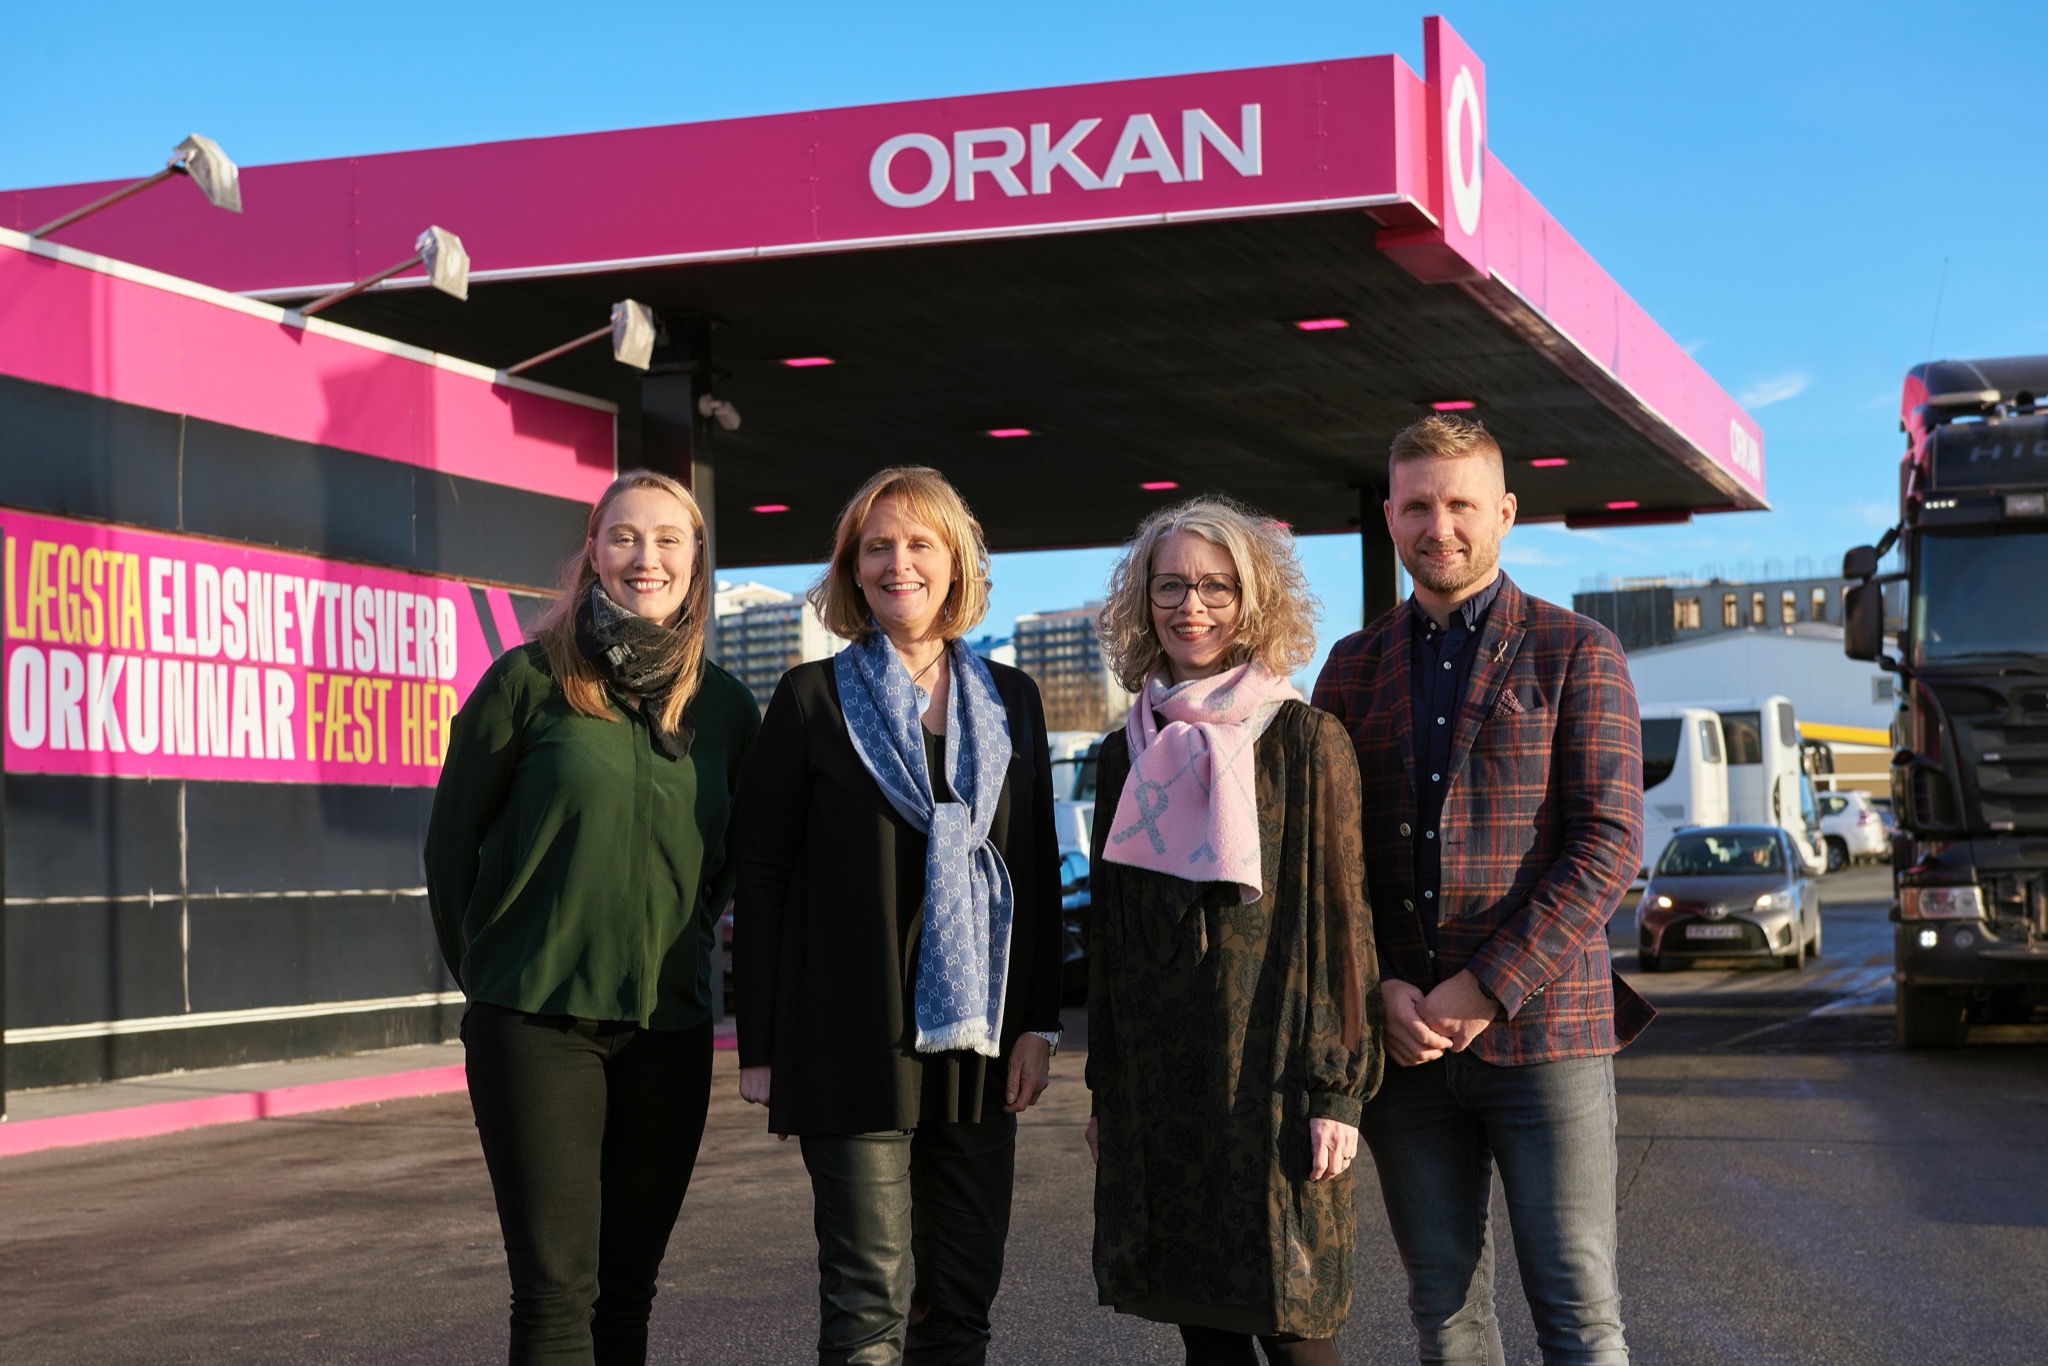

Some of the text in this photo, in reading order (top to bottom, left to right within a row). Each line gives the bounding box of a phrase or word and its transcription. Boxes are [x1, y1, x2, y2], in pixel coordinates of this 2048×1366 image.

[869, 103, 1262, 209] ORKAN
[5, 536, 457, 680] LÆGSTA ELDSNEYTISVERÐ
[8, 645, 295, 760] ORKUNNAR
[306, 671, 392, 764] FÆST
